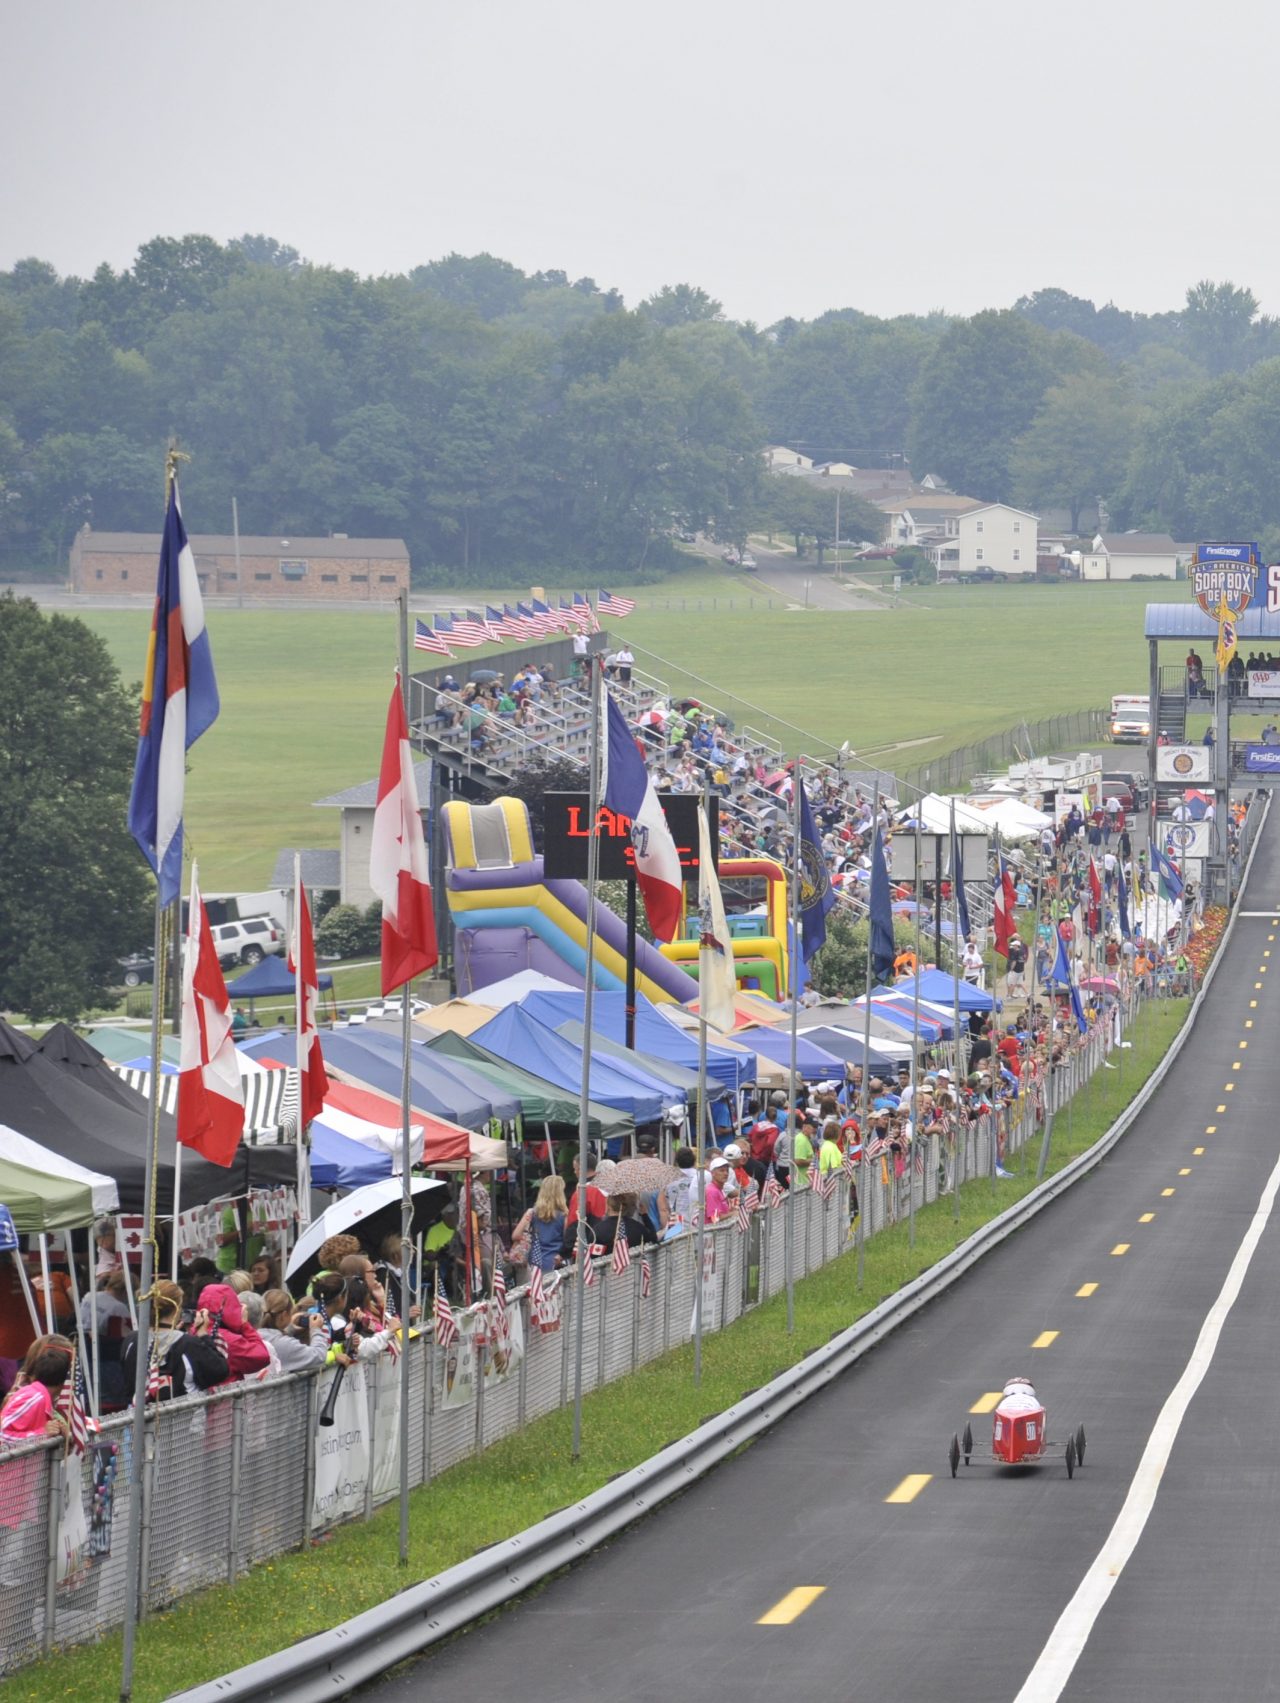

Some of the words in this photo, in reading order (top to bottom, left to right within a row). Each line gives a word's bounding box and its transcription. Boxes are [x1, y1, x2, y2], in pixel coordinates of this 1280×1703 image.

[1206, 547, 1242, 557] FirstEnergy
[1195, 572, 1225, 593] SOAP
[1227, 572, 1251, 593] BOX
[1207, 590, 1240, 602] DEBY
